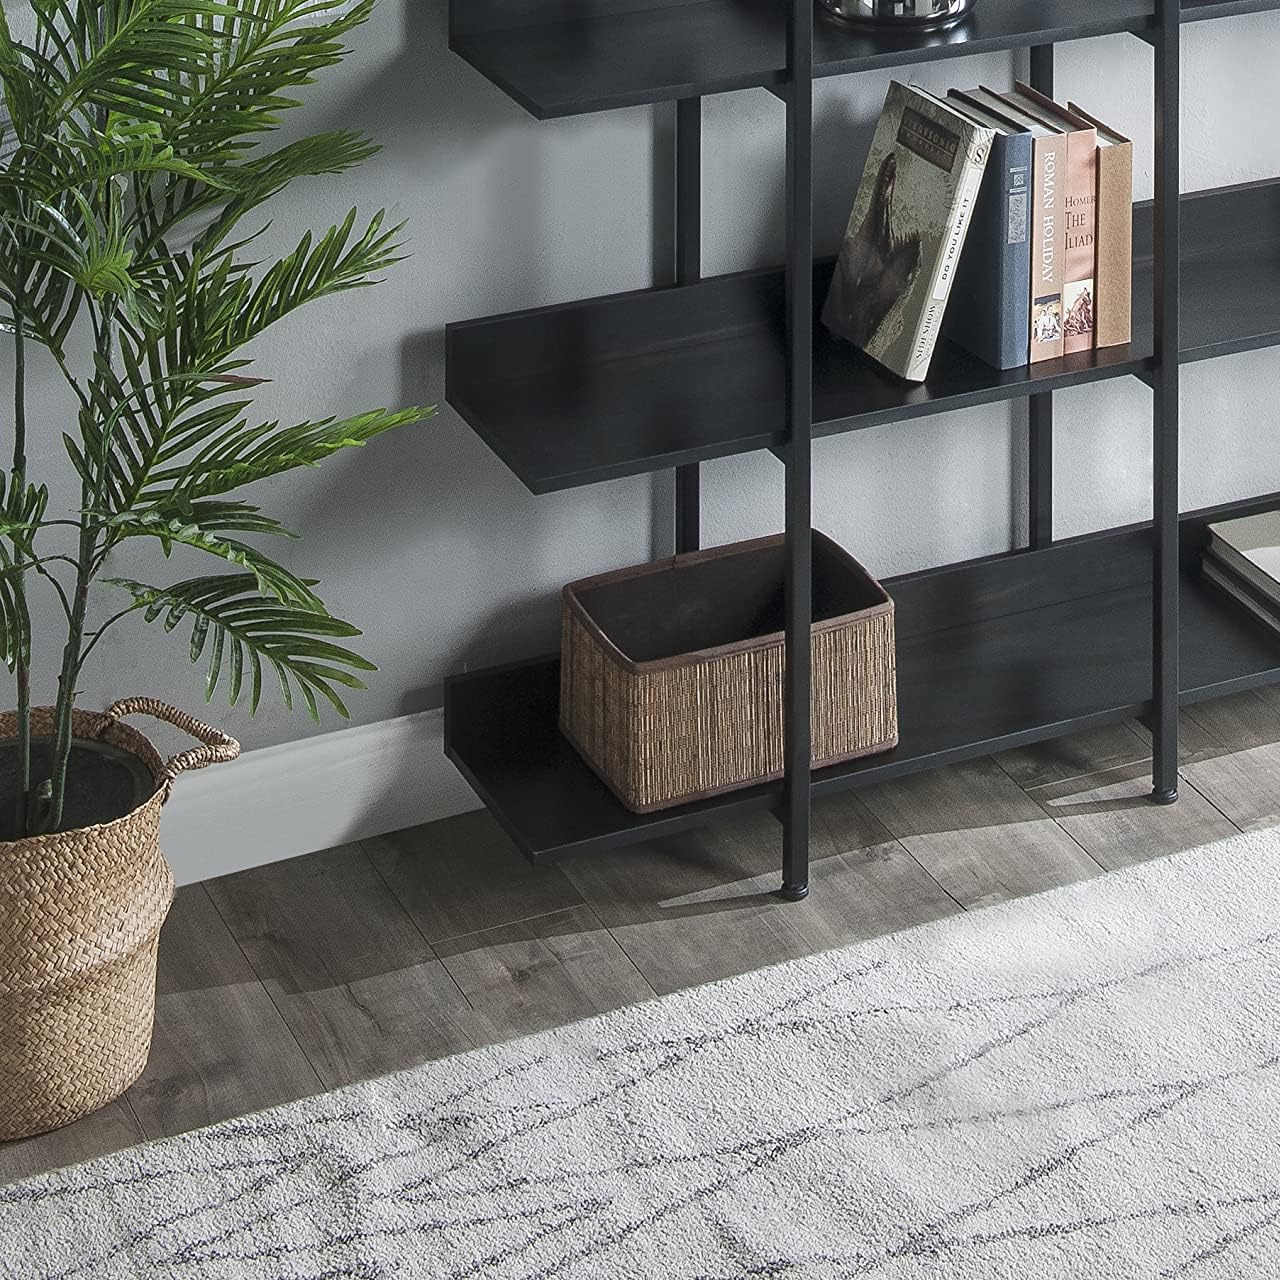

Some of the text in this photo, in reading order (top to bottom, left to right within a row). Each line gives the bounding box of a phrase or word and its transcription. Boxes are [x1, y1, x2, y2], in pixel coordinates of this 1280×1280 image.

[941, 265, 950, 280] DO
[947, 239, 958, 260] YOU
[954, 212, 966, 235] LIKE
[1042, 151, 1056, 283] ROMAN HOLIDAY
